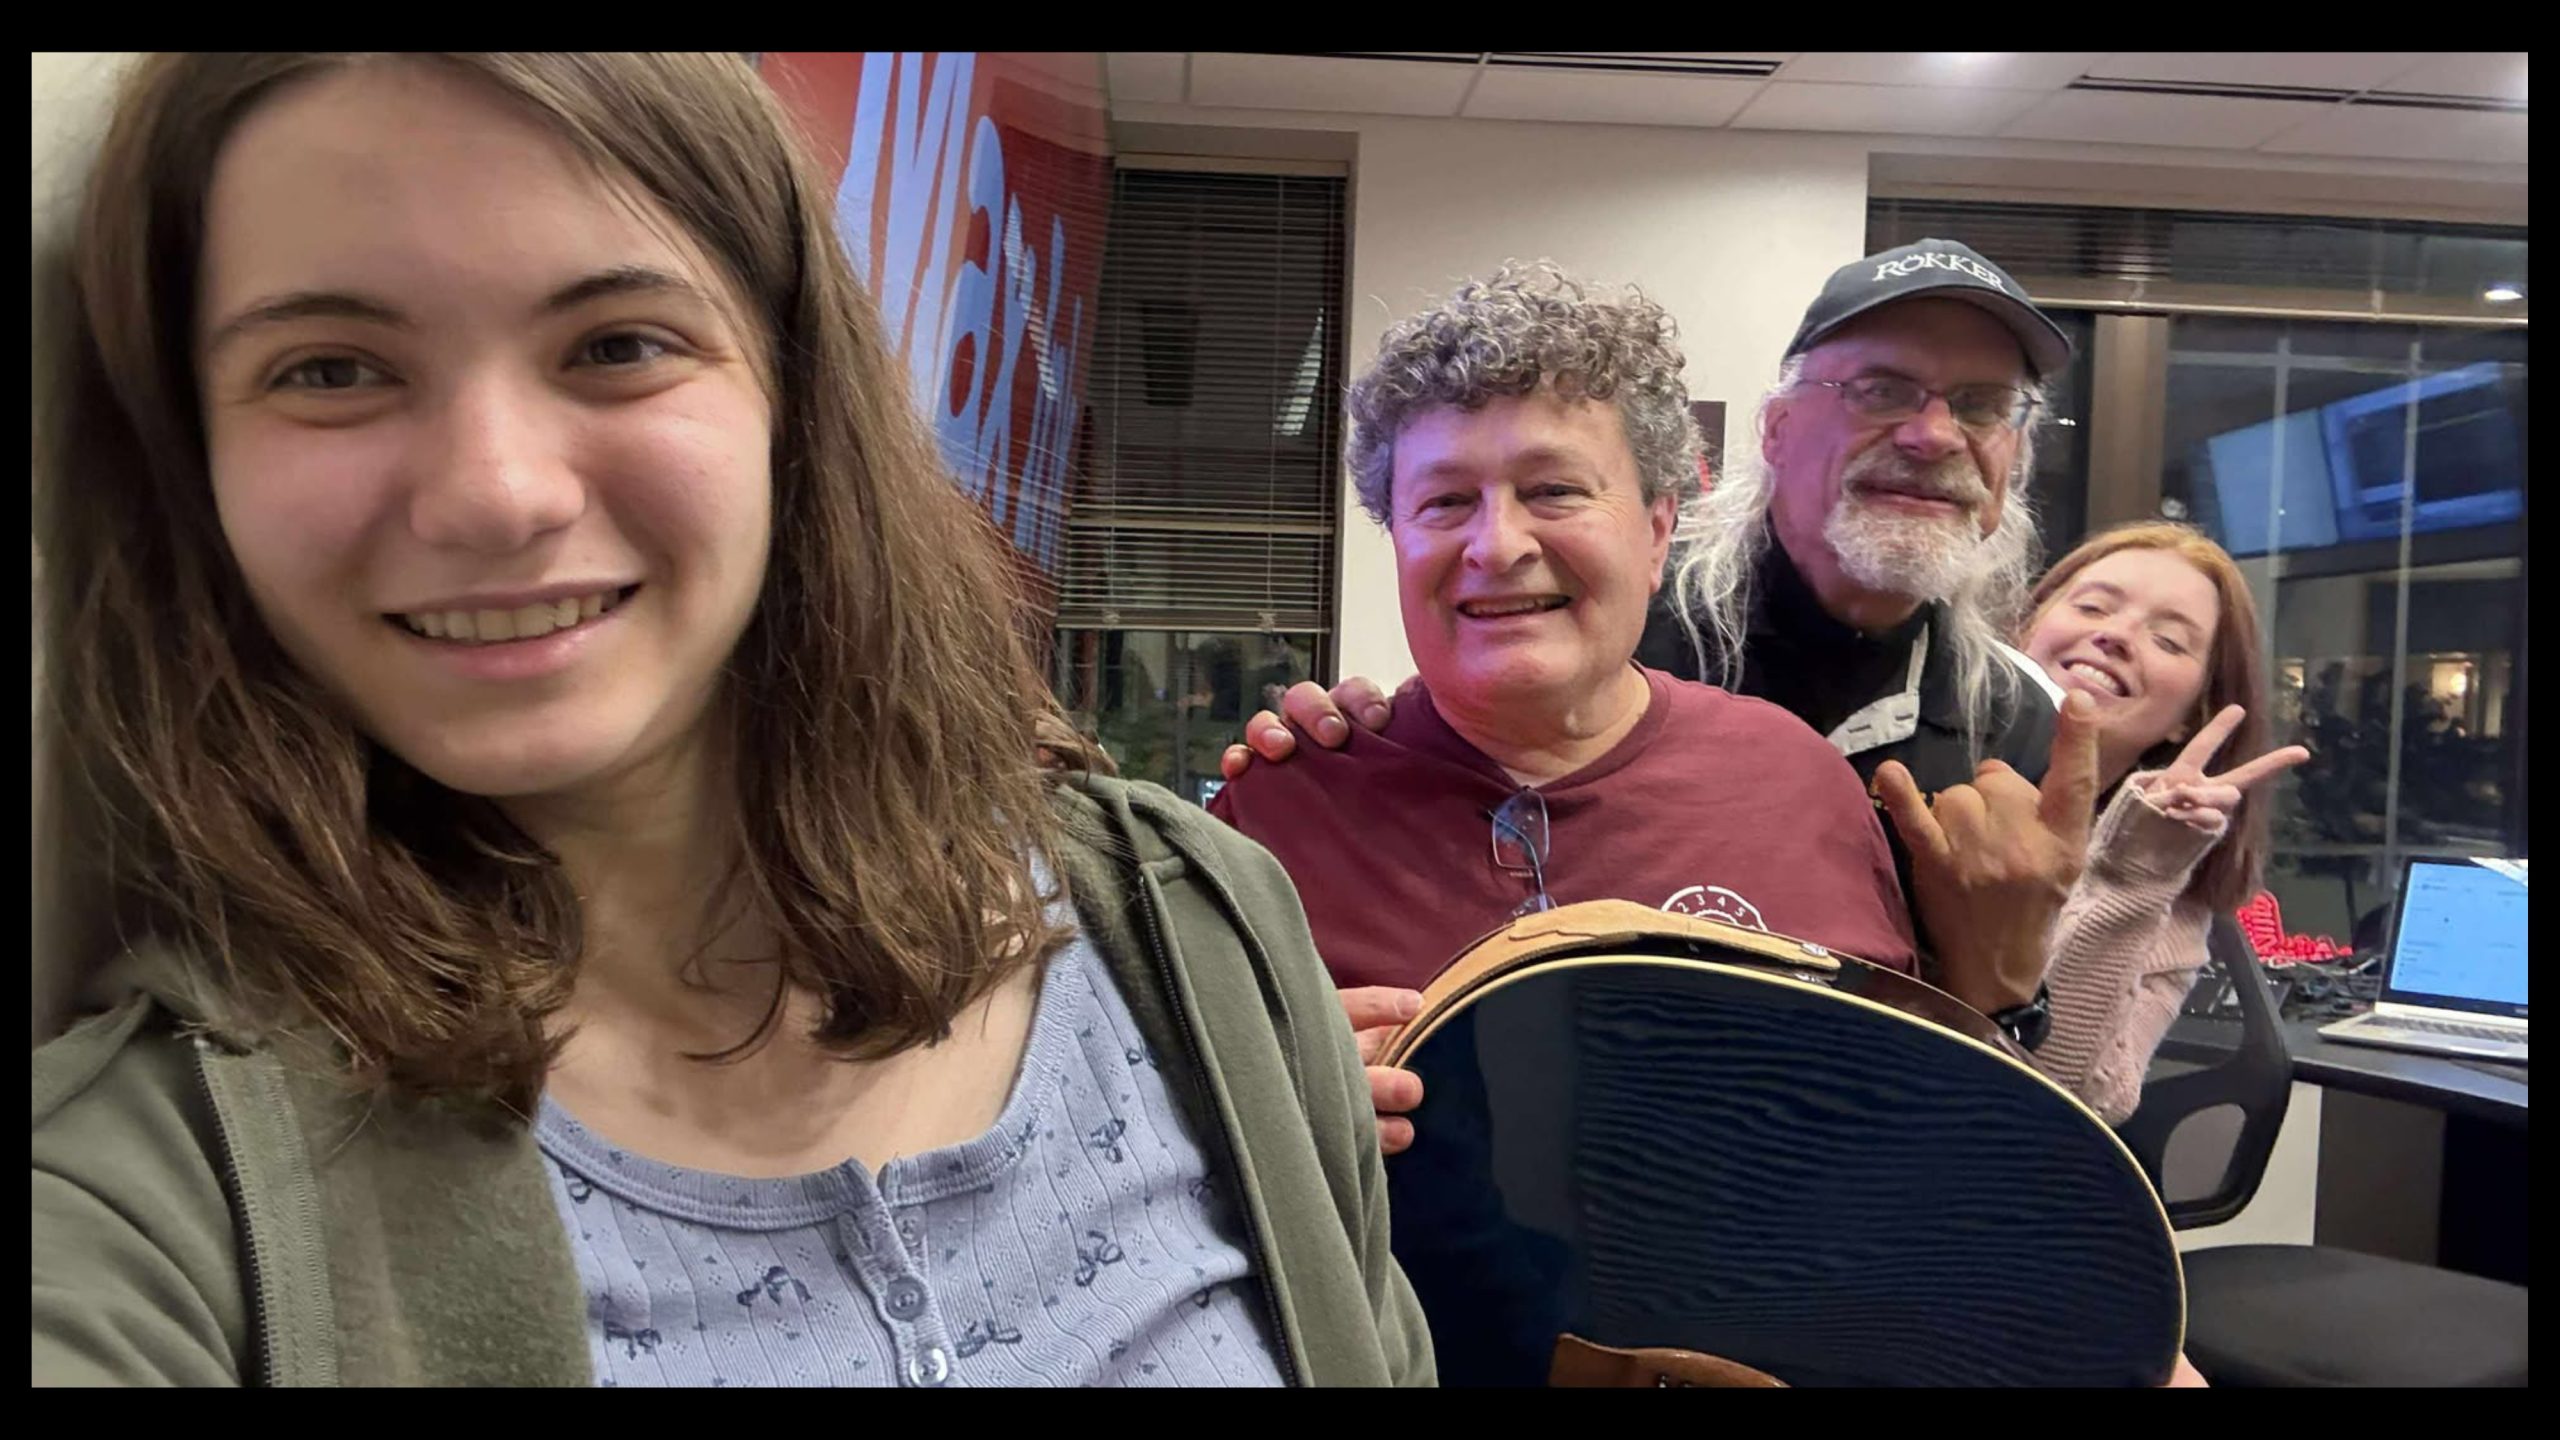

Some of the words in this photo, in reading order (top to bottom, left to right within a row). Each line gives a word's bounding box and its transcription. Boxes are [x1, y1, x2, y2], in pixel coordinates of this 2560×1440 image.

[1677, 902, 1690, 913] 2
[1696, 894, 1706, 906] 3
[1717, 896, 1727, 908] 4
[1735, 906, 1747, 918] 5
